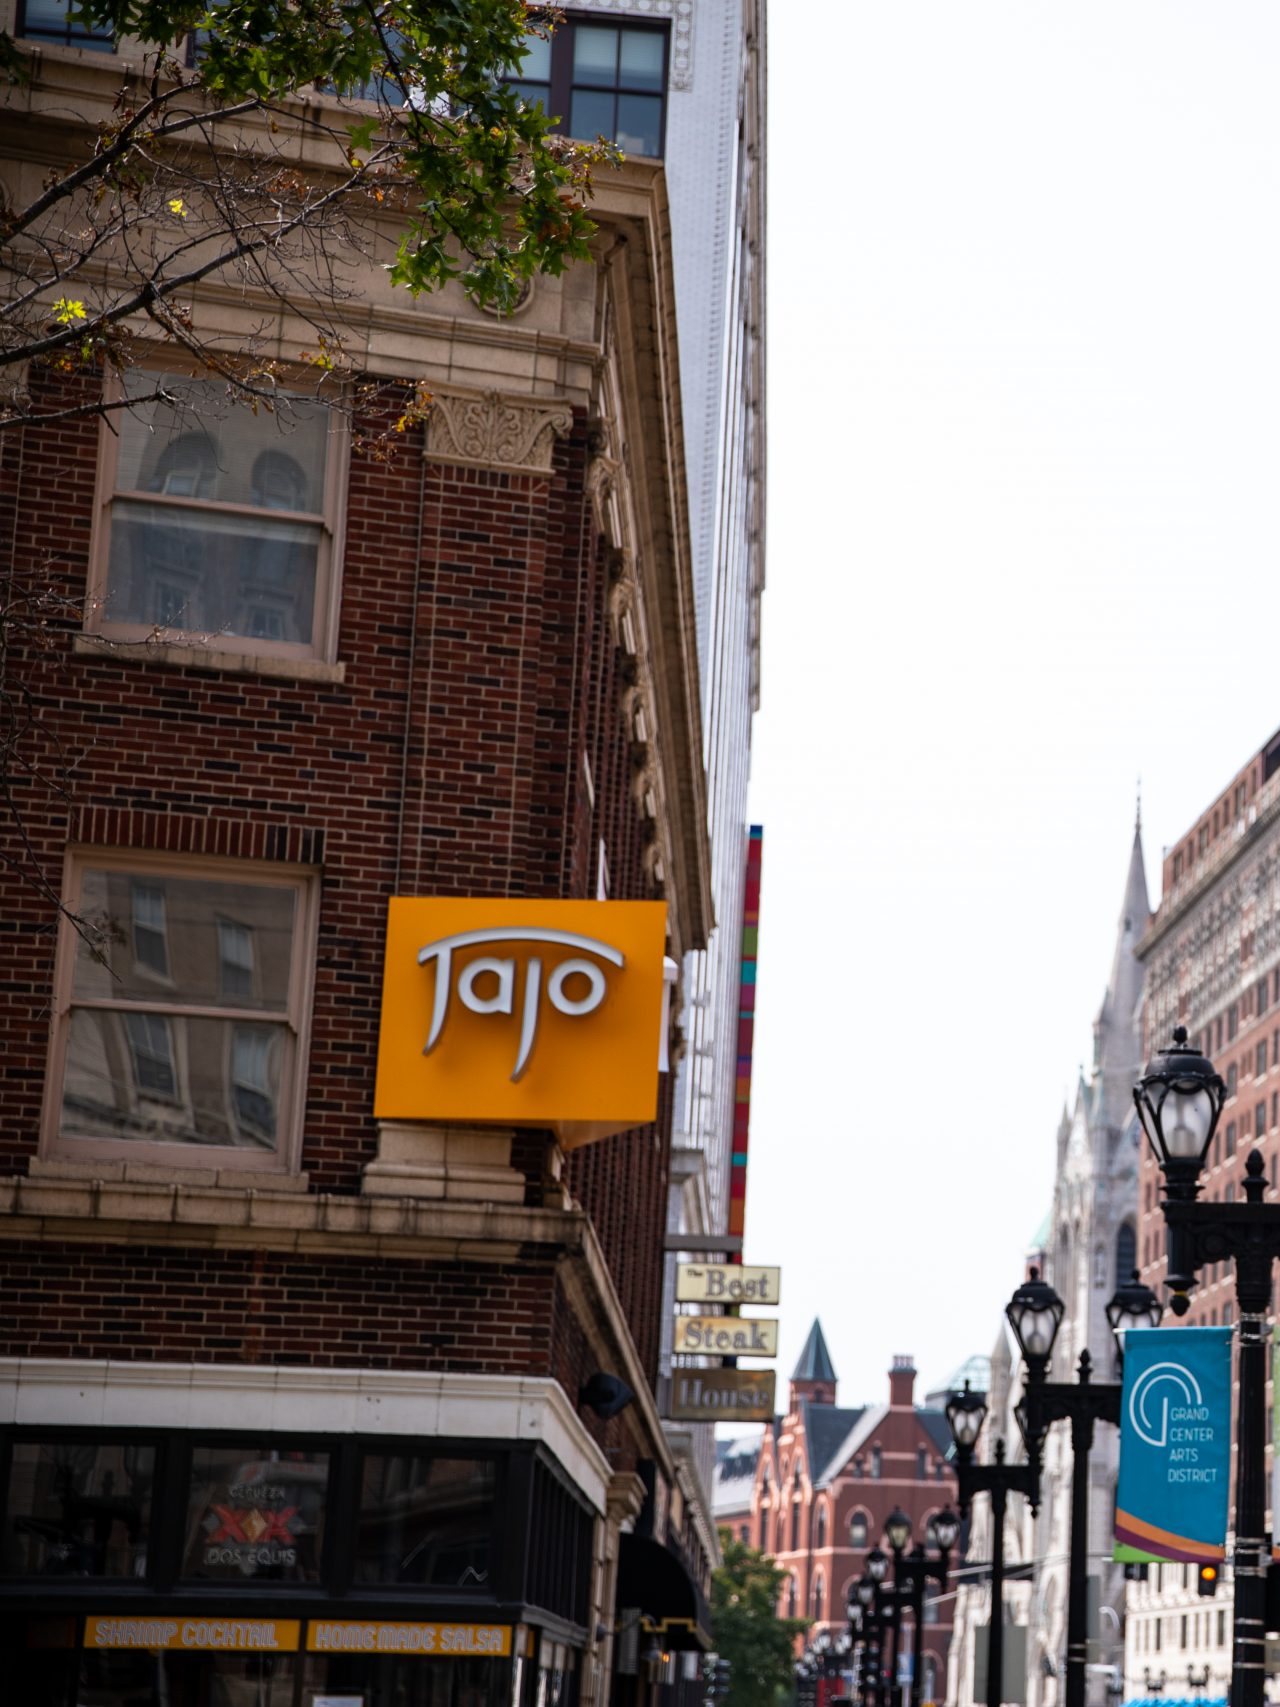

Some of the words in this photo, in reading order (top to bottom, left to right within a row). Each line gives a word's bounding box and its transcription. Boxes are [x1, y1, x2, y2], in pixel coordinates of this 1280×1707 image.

[417, 926, 625, 1084] Tajo
[706, 1269, 769, 1299] Best
[683, 1319, 769, 1351] Steak
[679, 1378, 769, 1410] House
[1170, 1407, 1209, 1421] GRAND
[1169, 1427, 1214, 1442] CENTER
[1168, 1447, 1199, 1462] ARTS
[1167, 1468, 1217, 1483] DISTRICT
[207, 1548, 241, 1566] DOS
[247, 1548, 296, 1567] EQUIS
[95, 1620, 178, 1647] SHRIMP
[181, 1621, 278, 1648] COCKTAIL
[440, 1626, 504, 1652] SALSA
